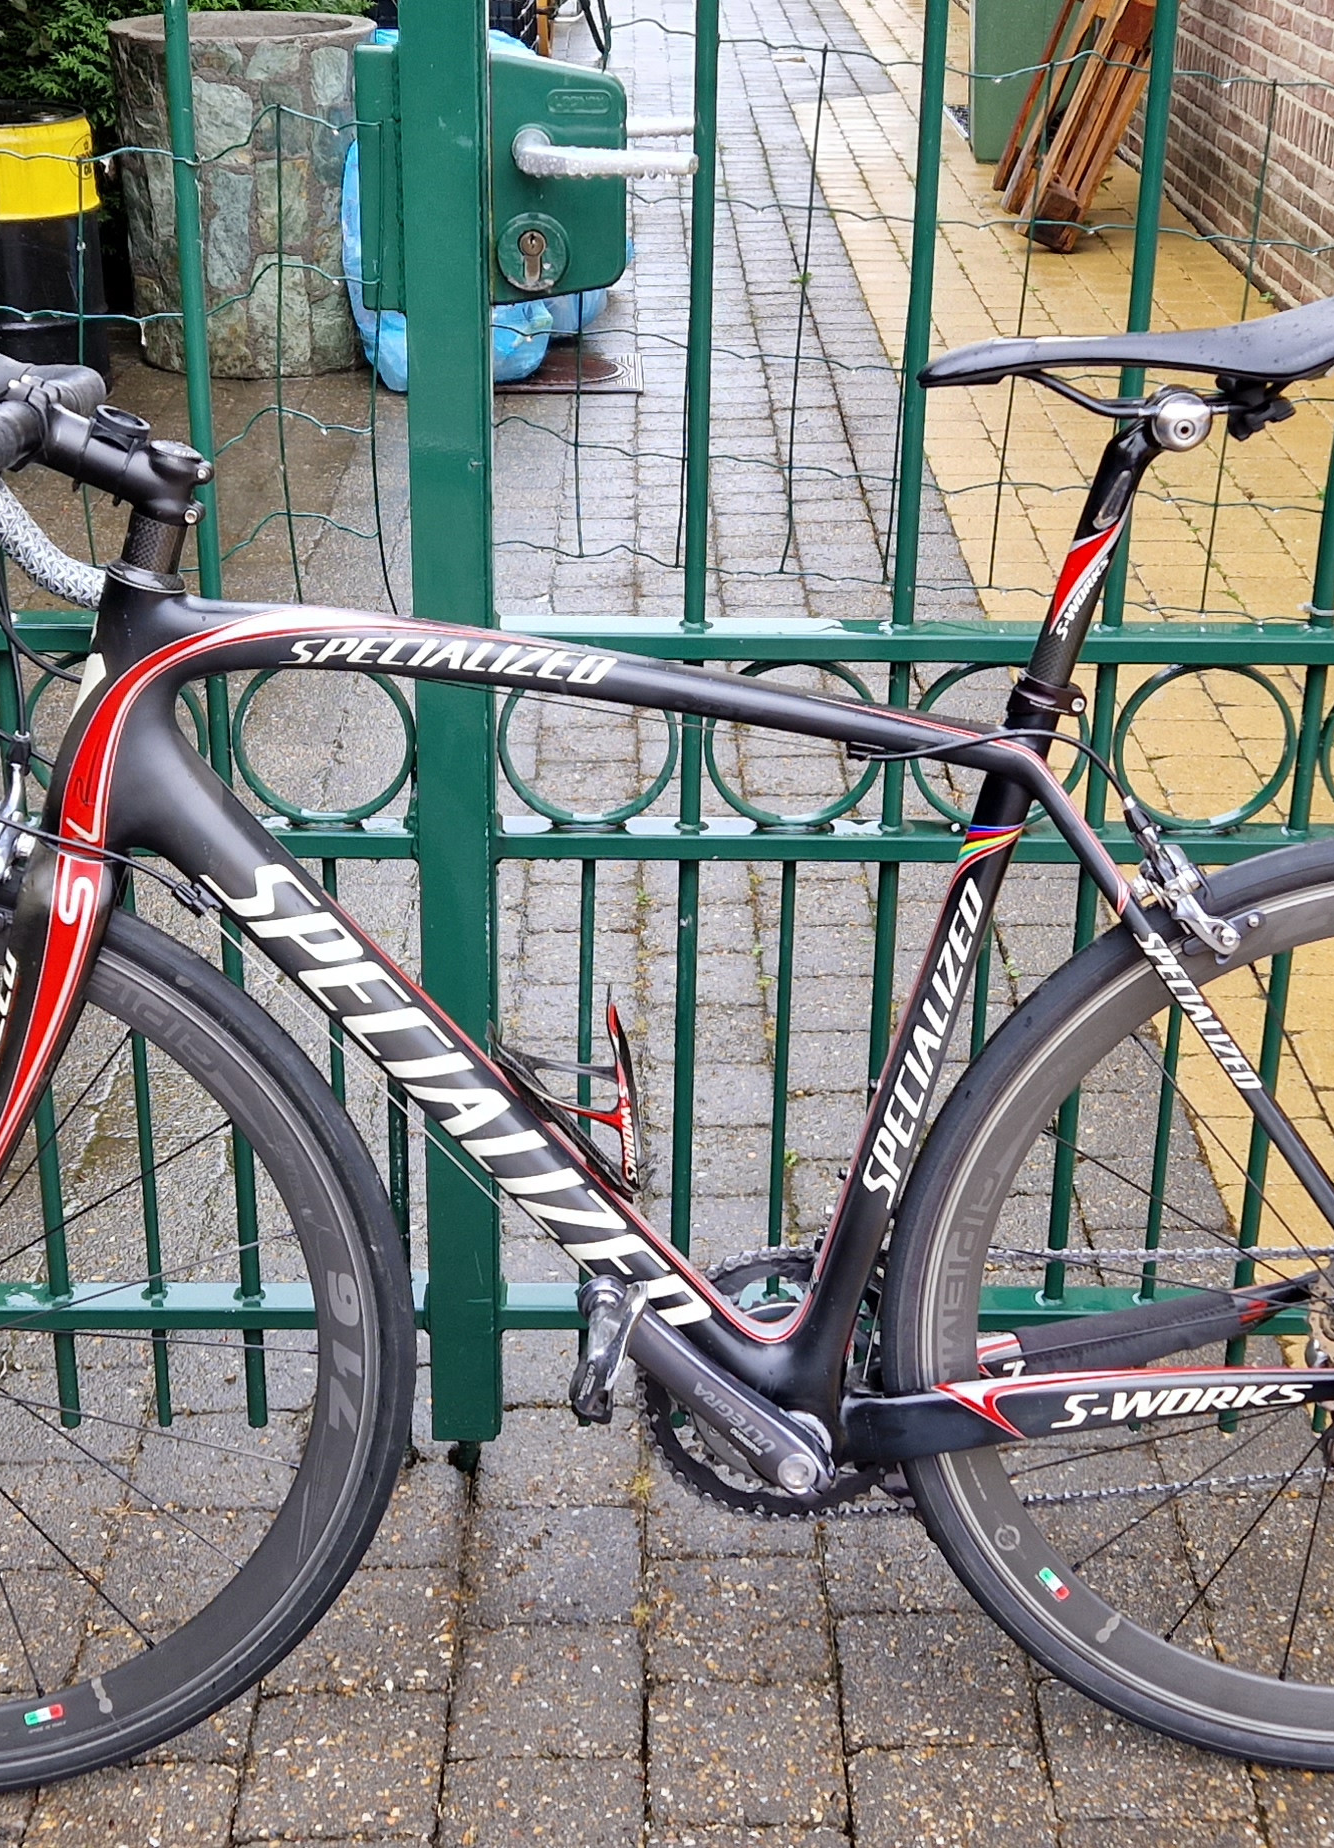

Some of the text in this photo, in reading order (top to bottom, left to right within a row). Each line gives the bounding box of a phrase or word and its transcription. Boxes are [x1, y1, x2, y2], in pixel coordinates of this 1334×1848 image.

[1055, 558, 1109, 641] S-WORKS
[279, 637, 618, 685] SPECIALIZED
[863, 877, 984, 1210] SPECIALIZED
[1133, 932, 1263, 1089] SPECIALIZED
[202, 863, 713, 1327] SPECIALIZED
[615, 1083, 641, 1187] S-WORKS
[327, 1270, 363, 1434] 716
[693, 1380, 777, 1454] ULTEGRA
[1050, 1383, 1313, 1429] S-WORKS
